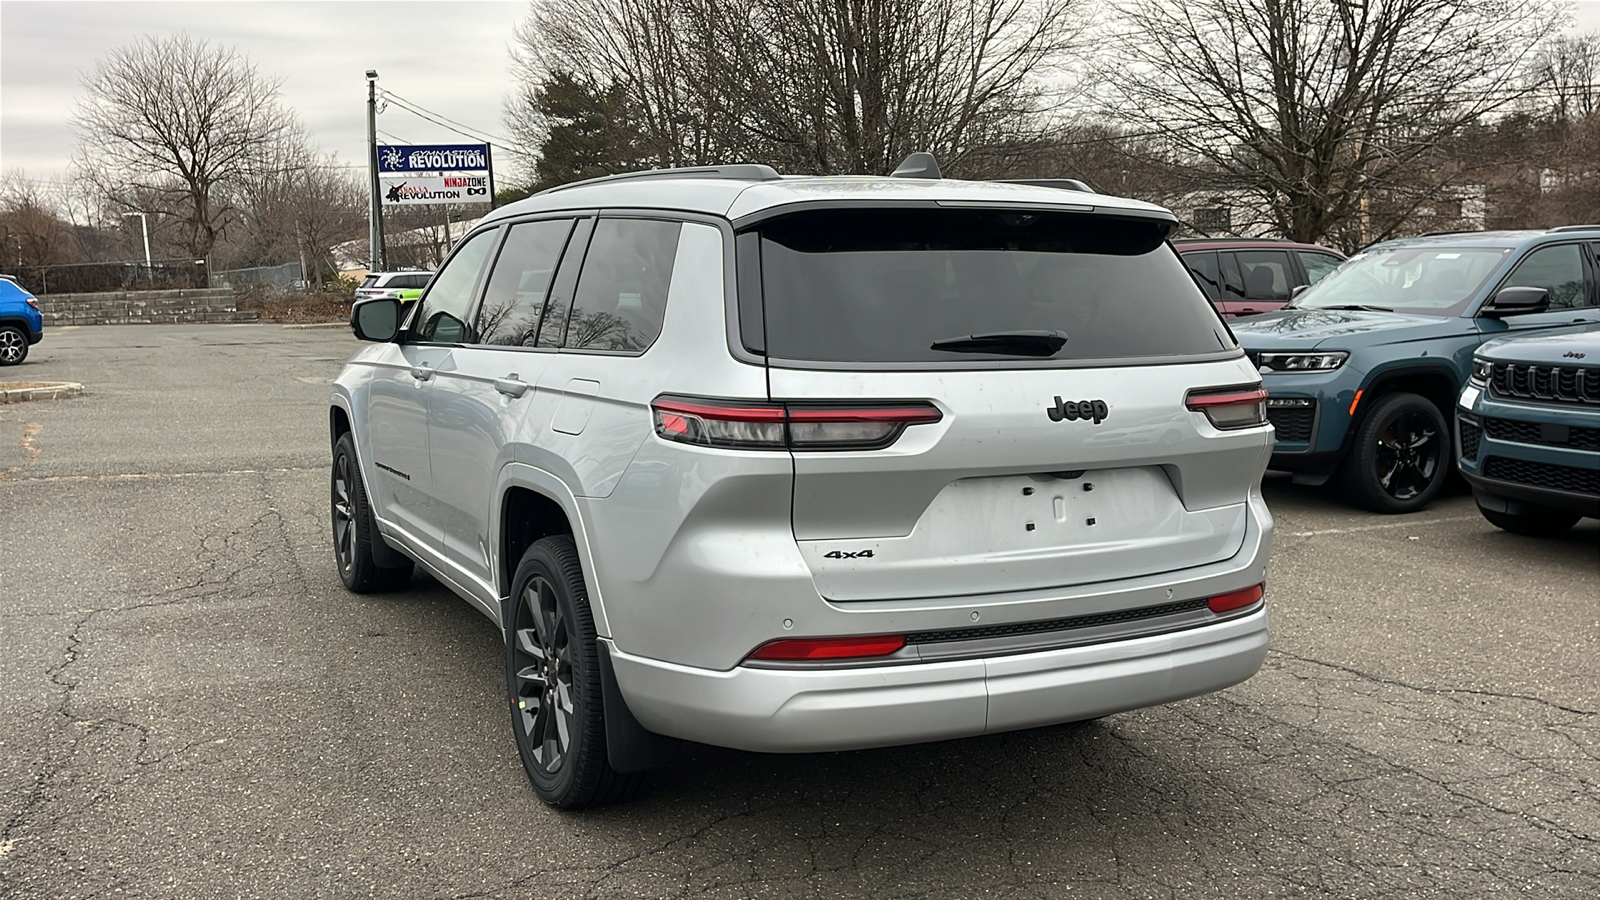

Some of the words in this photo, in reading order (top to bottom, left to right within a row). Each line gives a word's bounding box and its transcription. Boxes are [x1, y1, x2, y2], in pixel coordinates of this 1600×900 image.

[411, 149, 481, 158] GYMNASTICS
[409, 154, 486, 169] REVOLUTION
[399, 190, 460, 201] REVOLUTION
[1046, 395, 1109, 425] Jeep
[823, 549, 875, 559] 4x4
